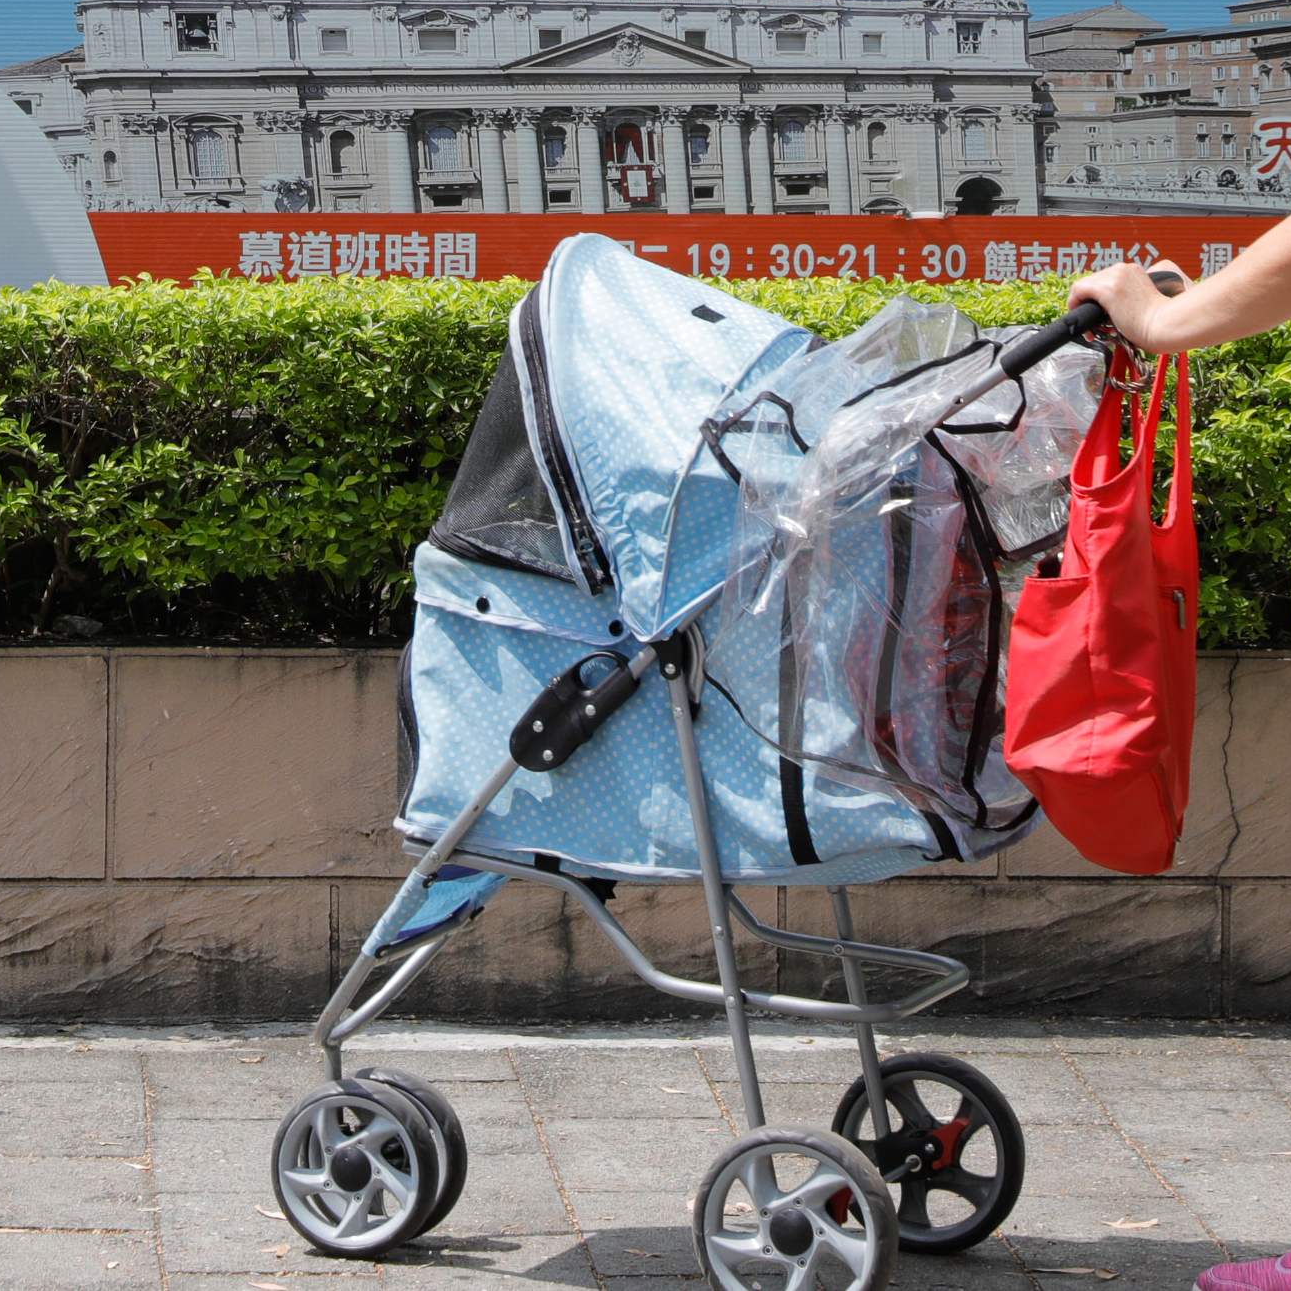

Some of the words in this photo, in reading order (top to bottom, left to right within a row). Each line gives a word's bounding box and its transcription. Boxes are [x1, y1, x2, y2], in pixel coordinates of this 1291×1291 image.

[237, 230, 478, 280] 慕道班時間
